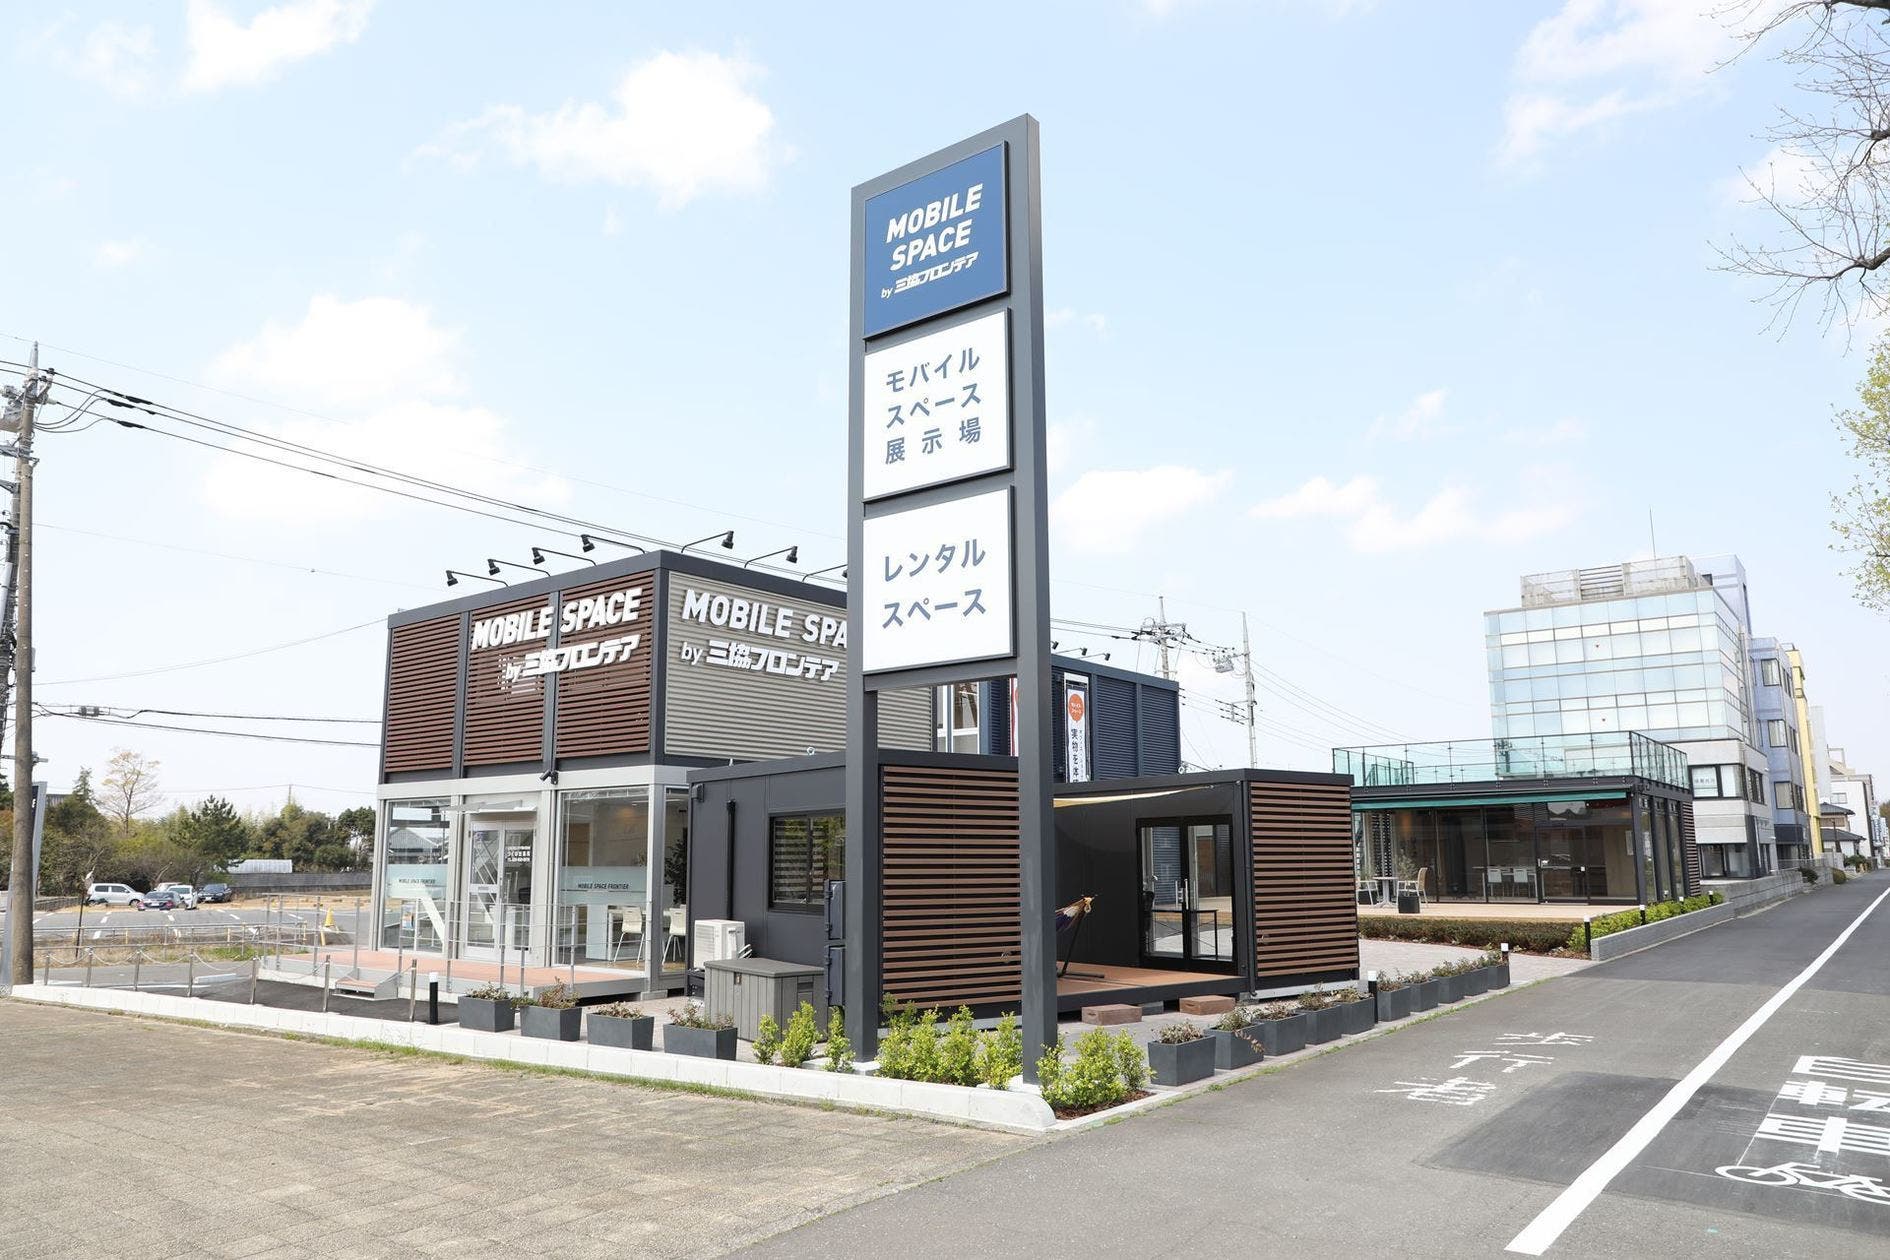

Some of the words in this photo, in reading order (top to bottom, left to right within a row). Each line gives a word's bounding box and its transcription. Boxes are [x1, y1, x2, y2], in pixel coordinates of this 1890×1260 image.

[885, 183, 984, 244] MOBILE
[889, 218, 974, 272] SPACE
[880, 286, 893, 299] by
[886, 347, 980, 393] モバイル
[886, 382, 982, 430] スペース
[885, 416, 982, 465] 展示場
[884, 538, 986, 583] レンタル
[471, 606, 555, 651] MOBILE
[560, 587, 643, 634] SPACE
[681, 588, 794, 639] MOBILE
[801, 613, 848, 649] SPA
[881, 588, 987, 630] スペース
[505, 662, 523, 683] by
[680, 641, 703, 666] by
